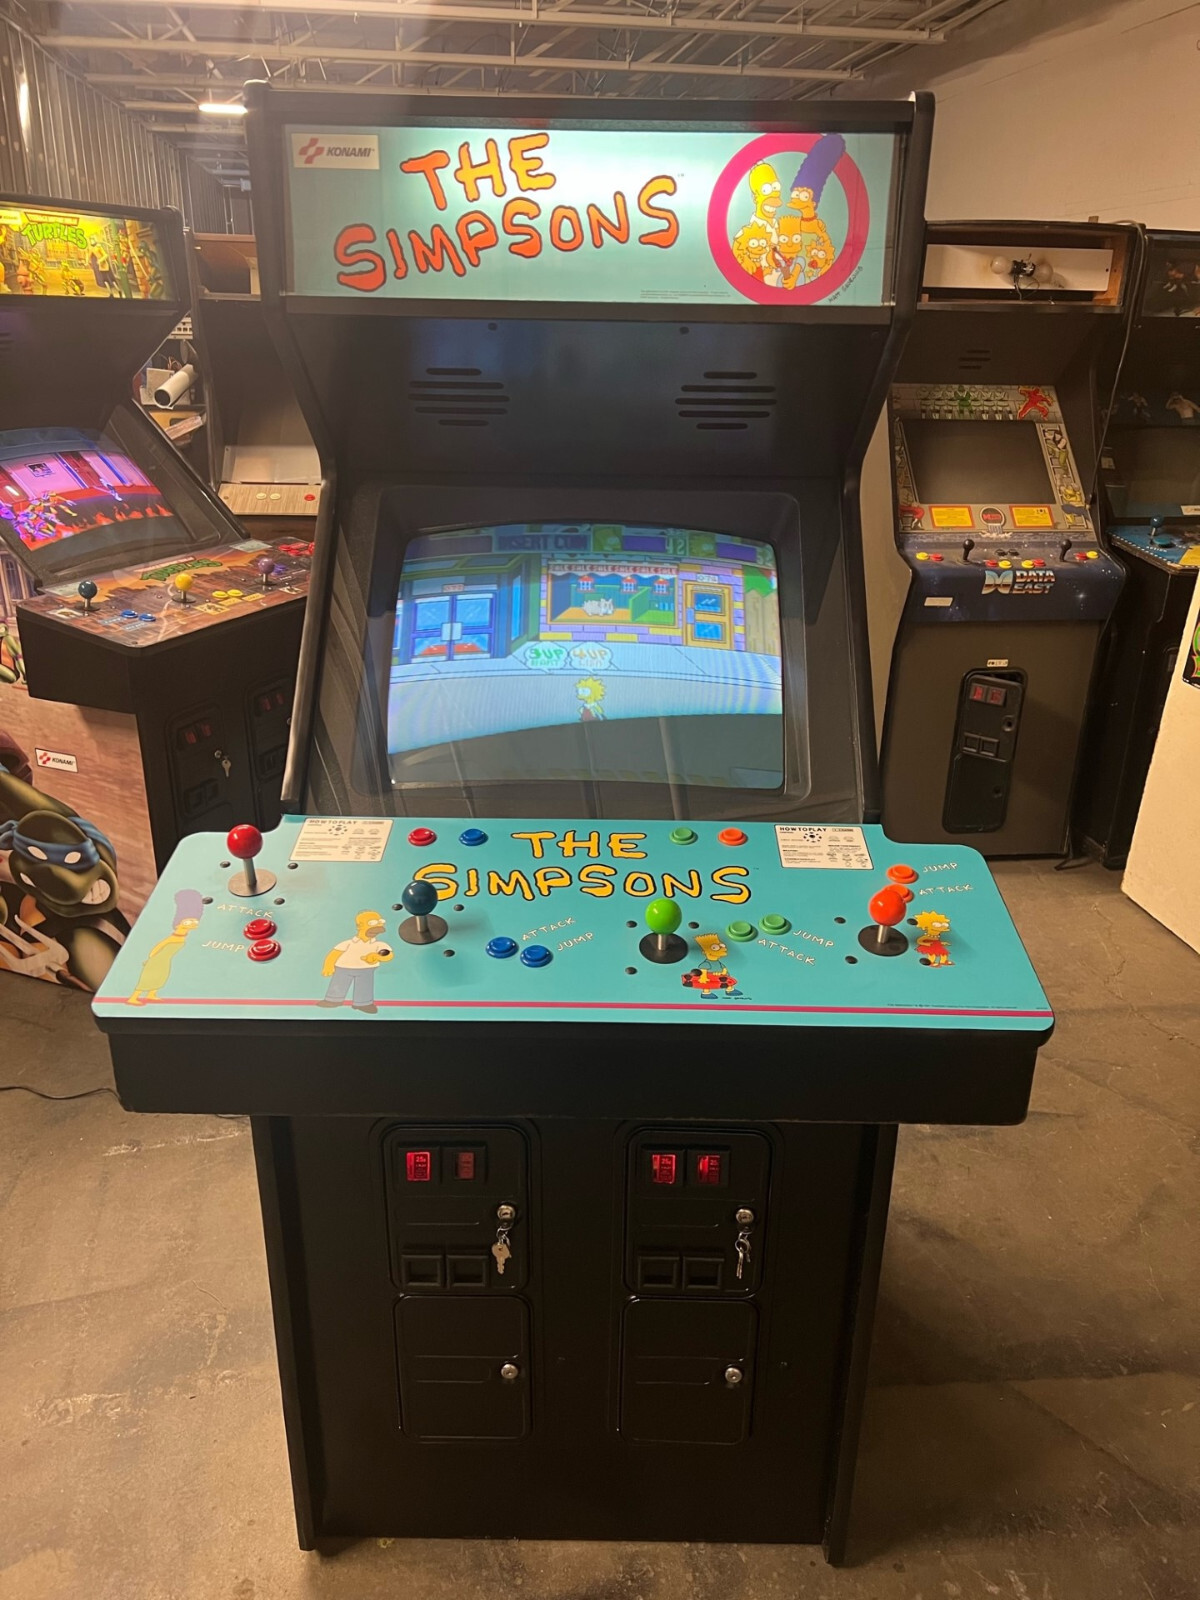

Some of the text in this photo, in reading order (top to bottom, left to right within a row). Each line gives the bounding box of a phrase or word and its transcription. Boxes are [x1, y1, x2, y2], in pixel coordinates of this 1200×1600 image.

[326, 146, 372, 157] KONAMI
[400, 132, 556, 210] THE
[20, 222, 88, 249] TURTLES
[334, 175, 679, 292] SIMPSONS
[1015, 570, 1056, 582] DATA
[1012, 582, 1055, 594] EAST
[52, 757, 74, 766] KONAMI
[511, 830, 649, 859] THE
[923, 862, 958, 873] JUMP
[413, 862, 752, 905] SIMPSONS
[919, 884, 974, 896] ATTACK
[216, 904, 274, 918] ATTACK
[522, 917, 576, 941] ATTACK
[201, 940, 245, 953] JUMP
[557, 932, 594, 951] JUMP
[793, 930, 835, 948] JUMP
[758, 939, 816, 966] ATTACK
